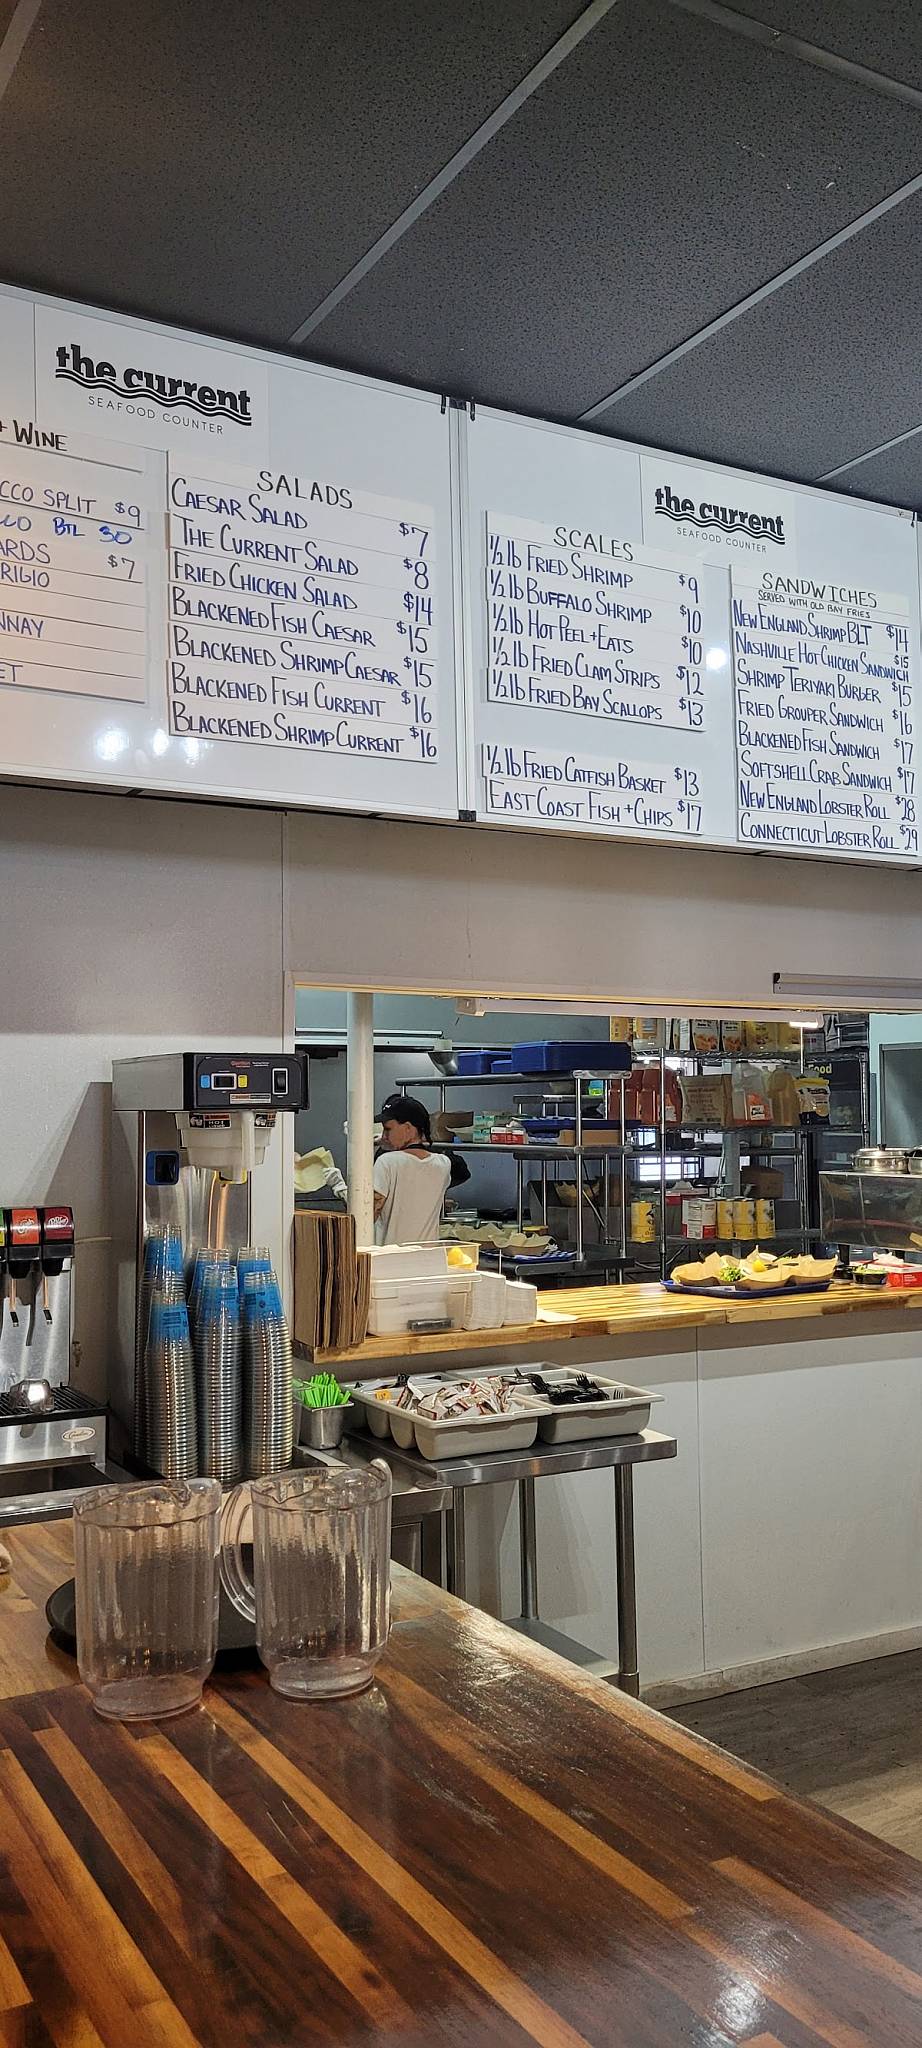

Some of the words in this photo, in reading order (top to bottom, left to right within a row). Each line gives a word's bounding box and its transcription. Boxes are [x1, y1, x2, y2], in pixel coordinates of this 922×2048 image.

[56, 344, 116, 382] the
[123, 368, 250, 415] current
[13, 420, 68, 451] WINE
[88, 396, 156, 418] SEAFOOD
[162, 413, 223, 434] COUNTER
[43, 489, 97, 514] SPLIT
[115, 502, 141, 527] $9
[257, 471, 352, 509] SALADS
[655, 486, 695, 514] the
[700, 503, 784, 536] current
[53, 516, 85, 536] BTL
[99, 526, 132, 544] 30
[172, 478, 246, 520] CAESAR
[248, 494, 308, 529] SALAD
[399, 522, 428, 557] $7
[677, 527, 722, 543] SEAFOOD
[726, 538, 767, 552] COUNTER
[108, 554, 136, 580] $7
[173, 514, 215, 548] THE
[220, 524, 302, 563] CURRENT
[305, 541, 358, 576] SALAD
[404, 558, 429, 590] $8
[554, 527, 633, 561] SCALES
[174, 551, 226, 586] FRIED
[229, 562, 296, 600] CHICKEN
[303, 576, 358, 610] SALAD
[403, 592, 434, 626] $14
[528, 544, 568, 576] FRIED
[571, 552, 633, 588] SHRIMP
[679, 574, 698, 604] $9
[762, 572, 877, 608] SANDWICHES
[173, 586, 270, 628] BLACKENED
[271, 602, 307, 634] FISH
[312, 610, 376, 647] CAESAR
[397, 620, 430, 654] $15
[527, 577, 592, 612] BUFFALO
[596, 590, 652, 623] SHRIMP
[680, 605, 702, 633] $10
[734, 600, 757, 628] NEW
[758, 603, 807, 635] ENGLAND
[808, 612, 846, 642] SHRIMP
[847, 622, 872, 646] BLT
[886, 625, 909, 652] $14
[758, 590, 785, 602] SERVED
[789, 598, 807, 608] WITH
[810, 602, 824, 610] OLD
[828, 605, 843, 614] BAY
[847, 608, 871, 618] FRIES
[174, 625, 276, 666] BLACKENED
[280, 640, 344, 675] SHRIMP
[345, 652, 402, 686] CAESAR
[404, 656, 435, 688] $15
[529, 609, 557, 639] HOT
[560, 615, 590, 643] PEEL
[681, 636, 702, 665] $10
[736, 631, 796, 662] NASHVILLE
[799, 641, 820, 665] HOT
[821, 645, 858, 672] CHICKEN
[860, 651, 909, 682] SANDWICH
[894, 655, 909, 668] $15
[172, 662, 267, 703] BLACKENED
[272, 676, 308, 708] FISH
[314, 682, 386, 717] CURRENT
[401, 690, 432, 724] $16
[533, 644, 573, 676] FRIED
[575, 653, 612, 683] CLAM
[615, 659, 660, 689] STRIPS
[676, 666, 704, 696] $12
[738, 658, 785, 689] SHRIMP
[783, 666, 835, 698] TERIYAKI
[837, 674, 881, 703] BURGER
[892, 682, 912, 707] $15
[529, 677, 571, 707] FRIED
[573, 684, 599, 712] BAY
[603, 689, 662, 720] SCALLOPS
[679, 697, 703, 725] $13
[738, 689, 774, 718] FRIED
[778, 695, 828, 726] GROUPER
[829, 702, 883, 732] SANDWICH
[893, 709, 912, 735] $16
[173, 701, 272, 739] BLACKENED
[274, 712, 334, 748] SHRIMP
[336, 720, 405, 753] CURRENT
[410, 726, 438, 758] $16
[739, 720, 801, 750] BLACKENED
[802, 728, 826, 754] FISH
[829, 731, 880, 760] SANDWICH
[894, 738, 913, 764] $17
[524, 750, 562, 780] FRIED
[565, 756, 614, 786] CATFISH
[619, 763, 667, 793] BASKET
[675, 767, 699, 796] $13
[810, 759, 841, 786] CRAB
[842, 762, 892, 792] SANDWICH
[897, 767, 914, 794] $17
[490, 780, 536, 811] EAST
[537, 786, 585, 817] COAST
[589, 791, 620, 822] FISH
[634, 798, 673, 827] CHIPS
[678, 800, 701, 831] $17
[740, 780, 765, 809] NEW
[766, 783, 817, 814] ENGLAND
[819, 789, 864, 818] LOBSTER
[864, 794, 891, 819] ROLL
[895, 795, 915, 822] $28
[741, 812, 824, 843] CONNECTICUT
[824, 821, 872, 848] LOBSTER
[873, 826, 900, 849] ROLL
[900, 825, 918, 851] $29
